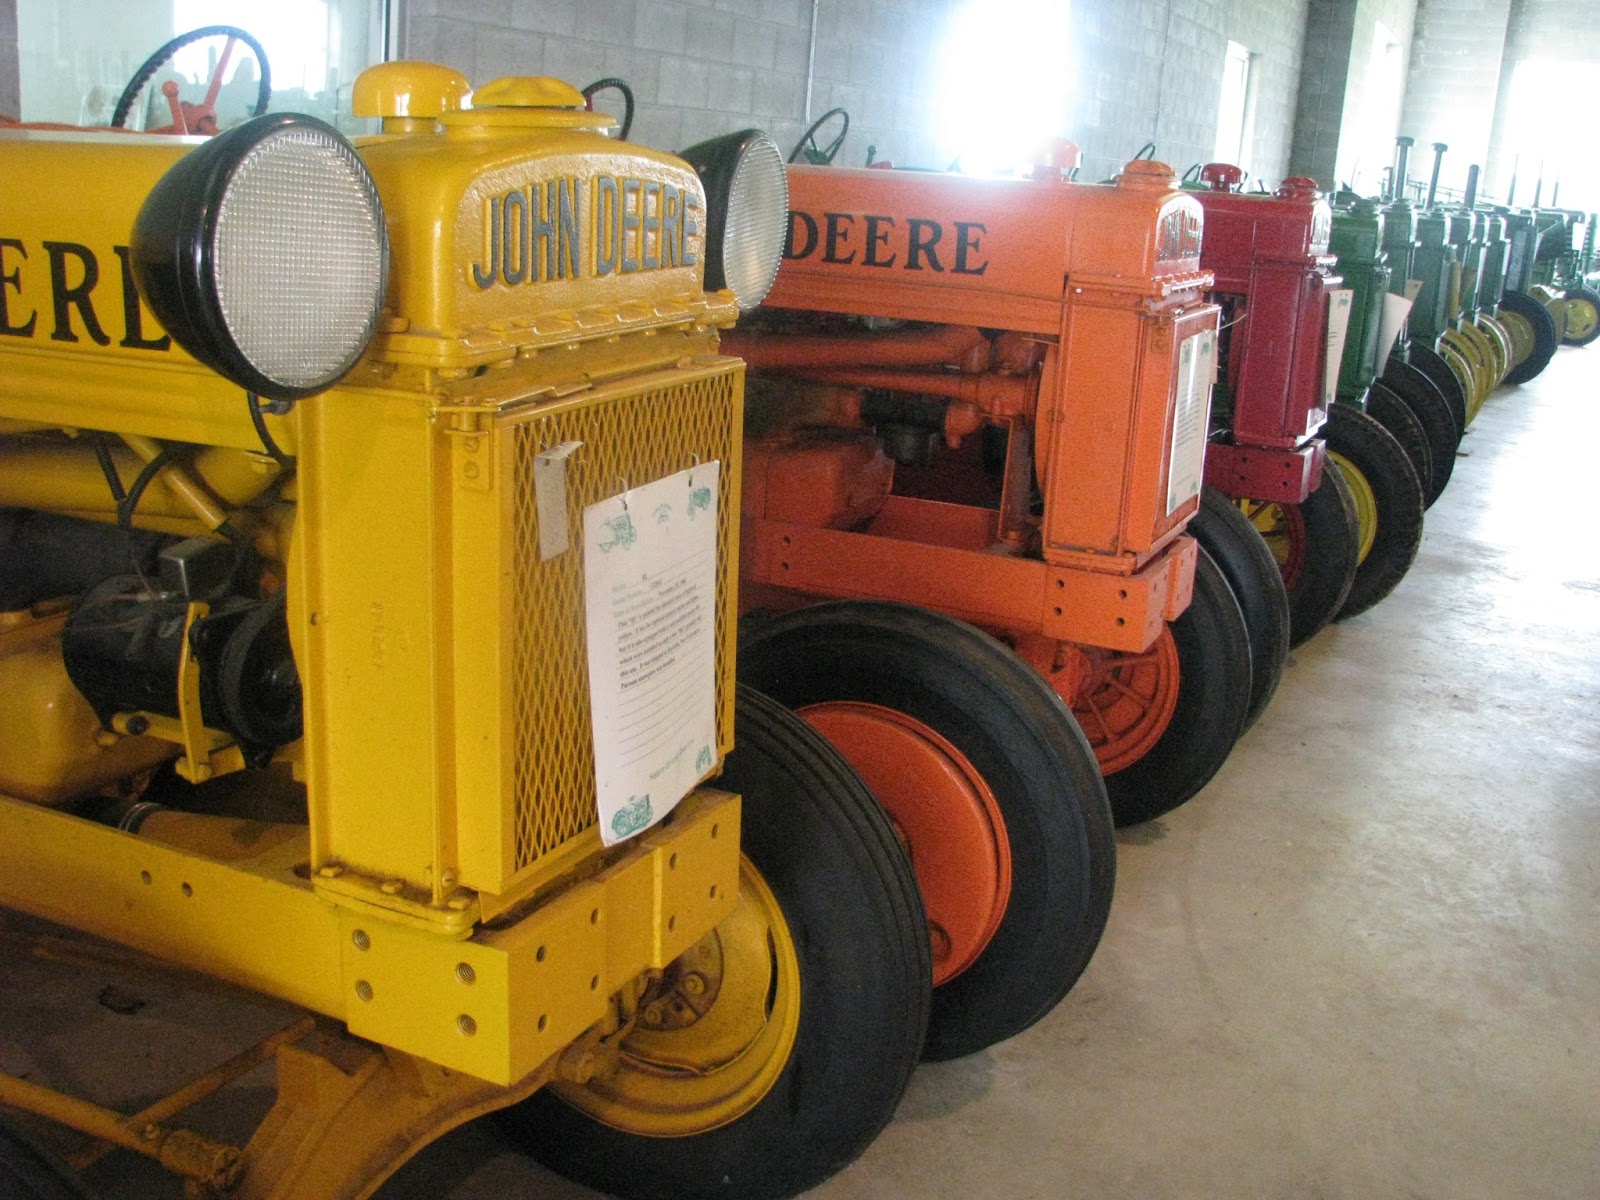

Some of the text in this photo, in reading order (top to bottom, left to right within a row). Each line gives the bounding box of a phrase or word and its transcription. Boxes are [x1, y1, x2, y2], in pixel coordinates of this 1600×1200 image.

[472, 175, 699, 289] JOHN DEERE
[782, 210, 989, 276] DEERE
